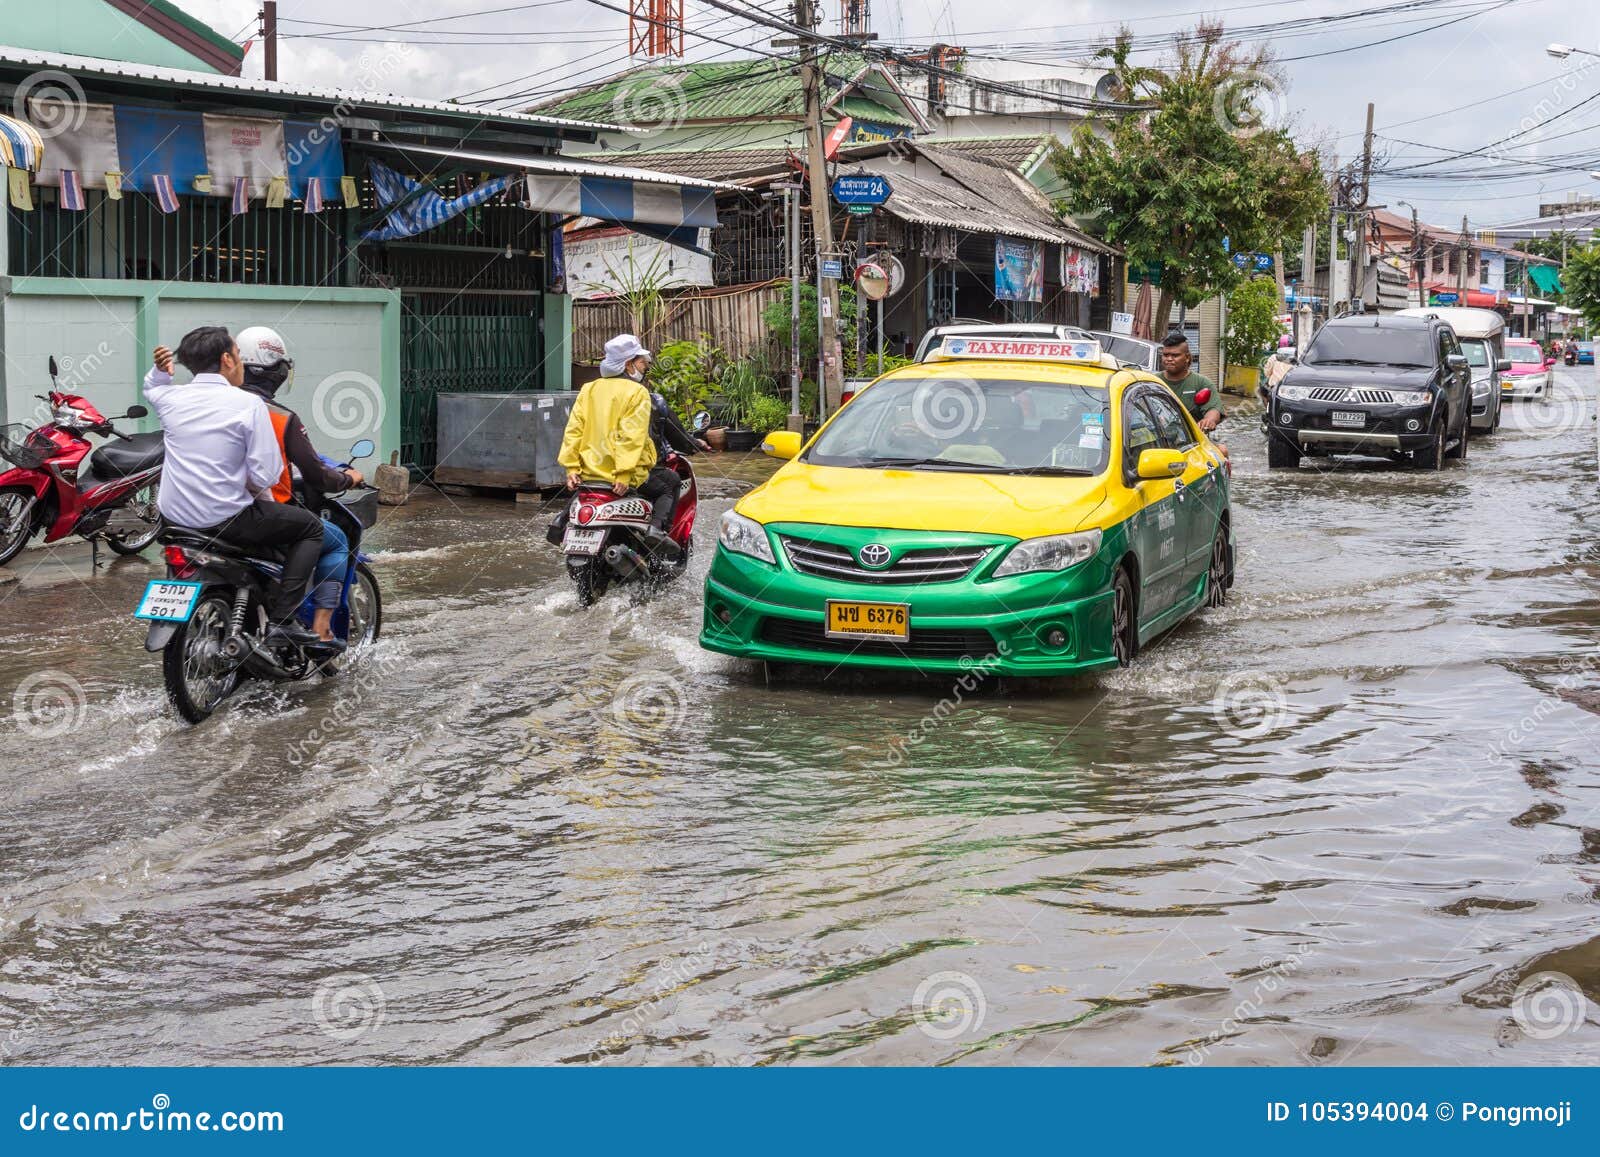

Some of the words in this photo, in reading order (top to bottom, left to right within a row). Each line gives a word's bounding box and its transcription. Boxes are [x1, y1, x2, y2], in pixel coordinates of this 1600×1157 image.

[871, 182, 884, 196] 24
[1259, 256, 1269, 265] 22
[967, 341, 1073, 357] TAXI-METER
[150, 606, 176, 617] 501
[867, 608, 905, 625] 6376
